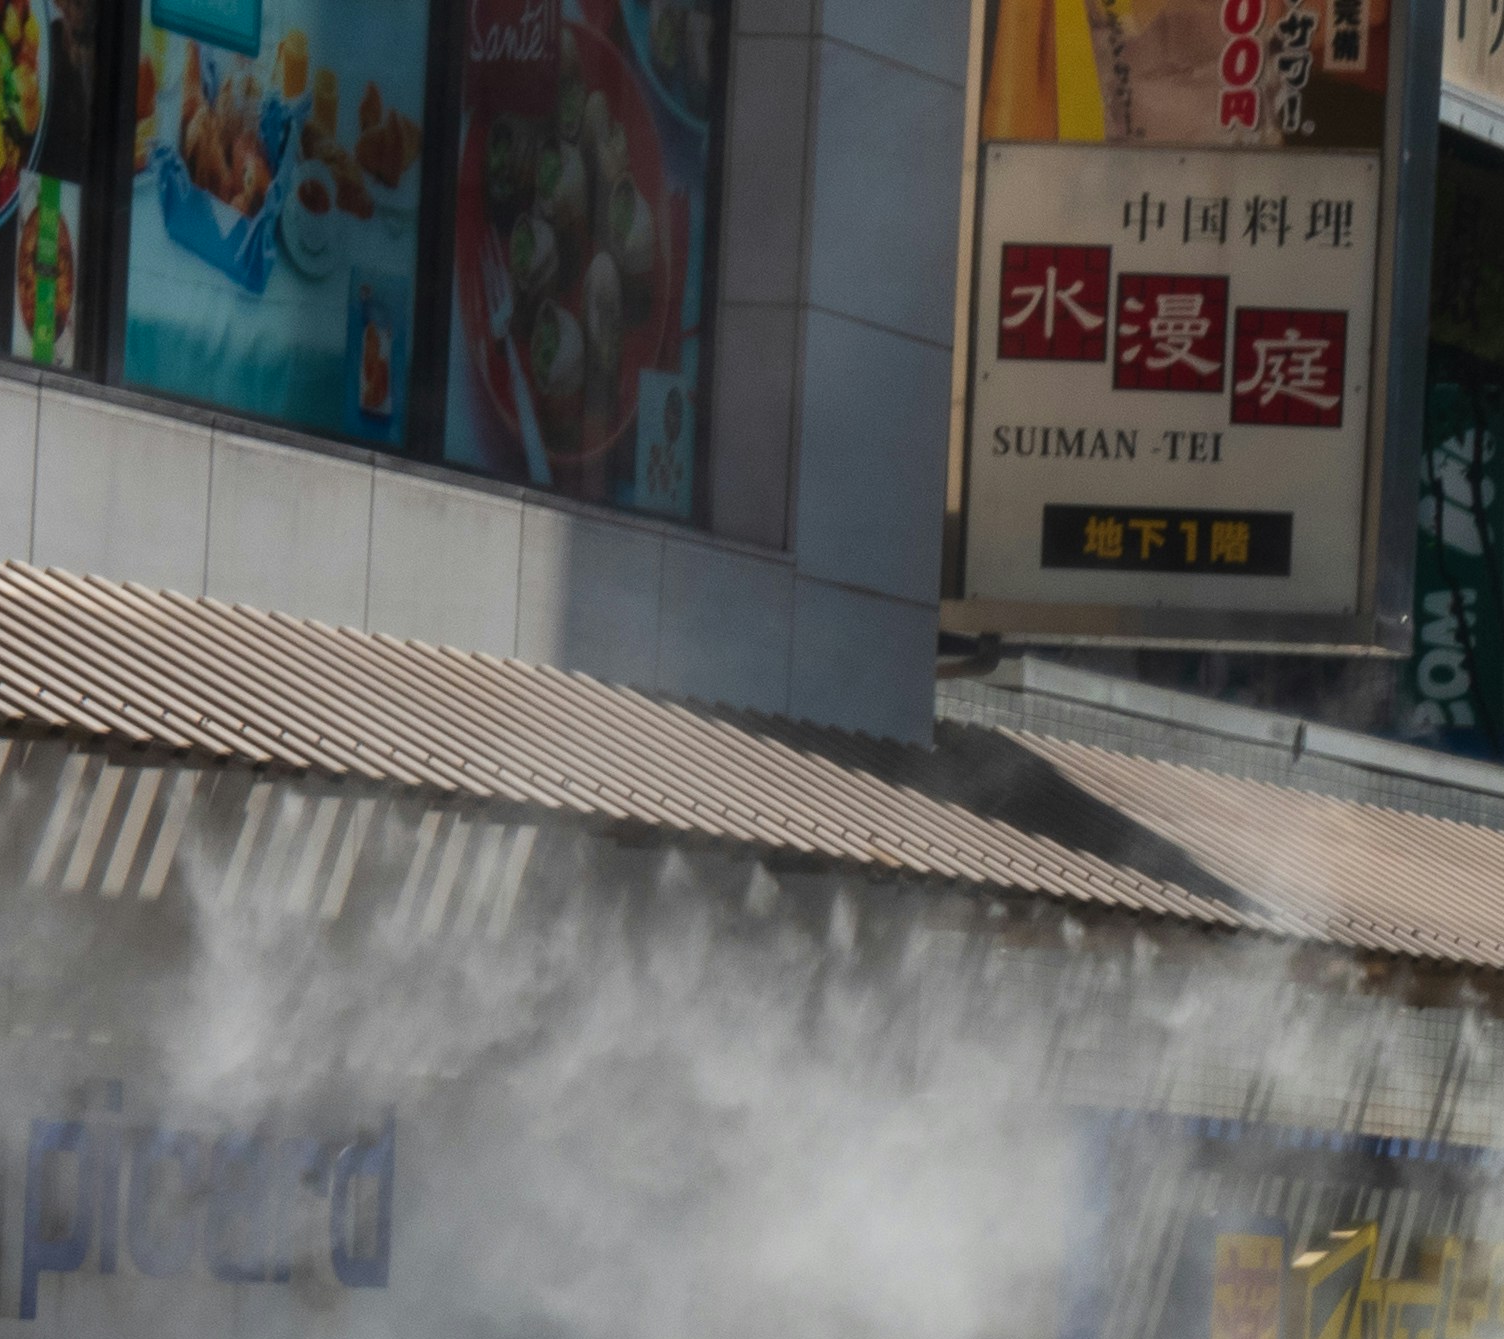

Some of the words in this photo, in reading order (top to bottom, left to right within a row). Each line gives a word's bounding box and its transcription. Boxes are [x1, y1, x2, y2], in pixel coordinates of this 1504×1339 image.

[1121, 190, 1355, 250] 中国料理
[1002, 266, 1340, 411] 水漫庭
[992, 424, 1139, 461] SUIMAN
[1083, 515, 1252, 564] 地下1階
[19, 1079, 398, 1321] picard
